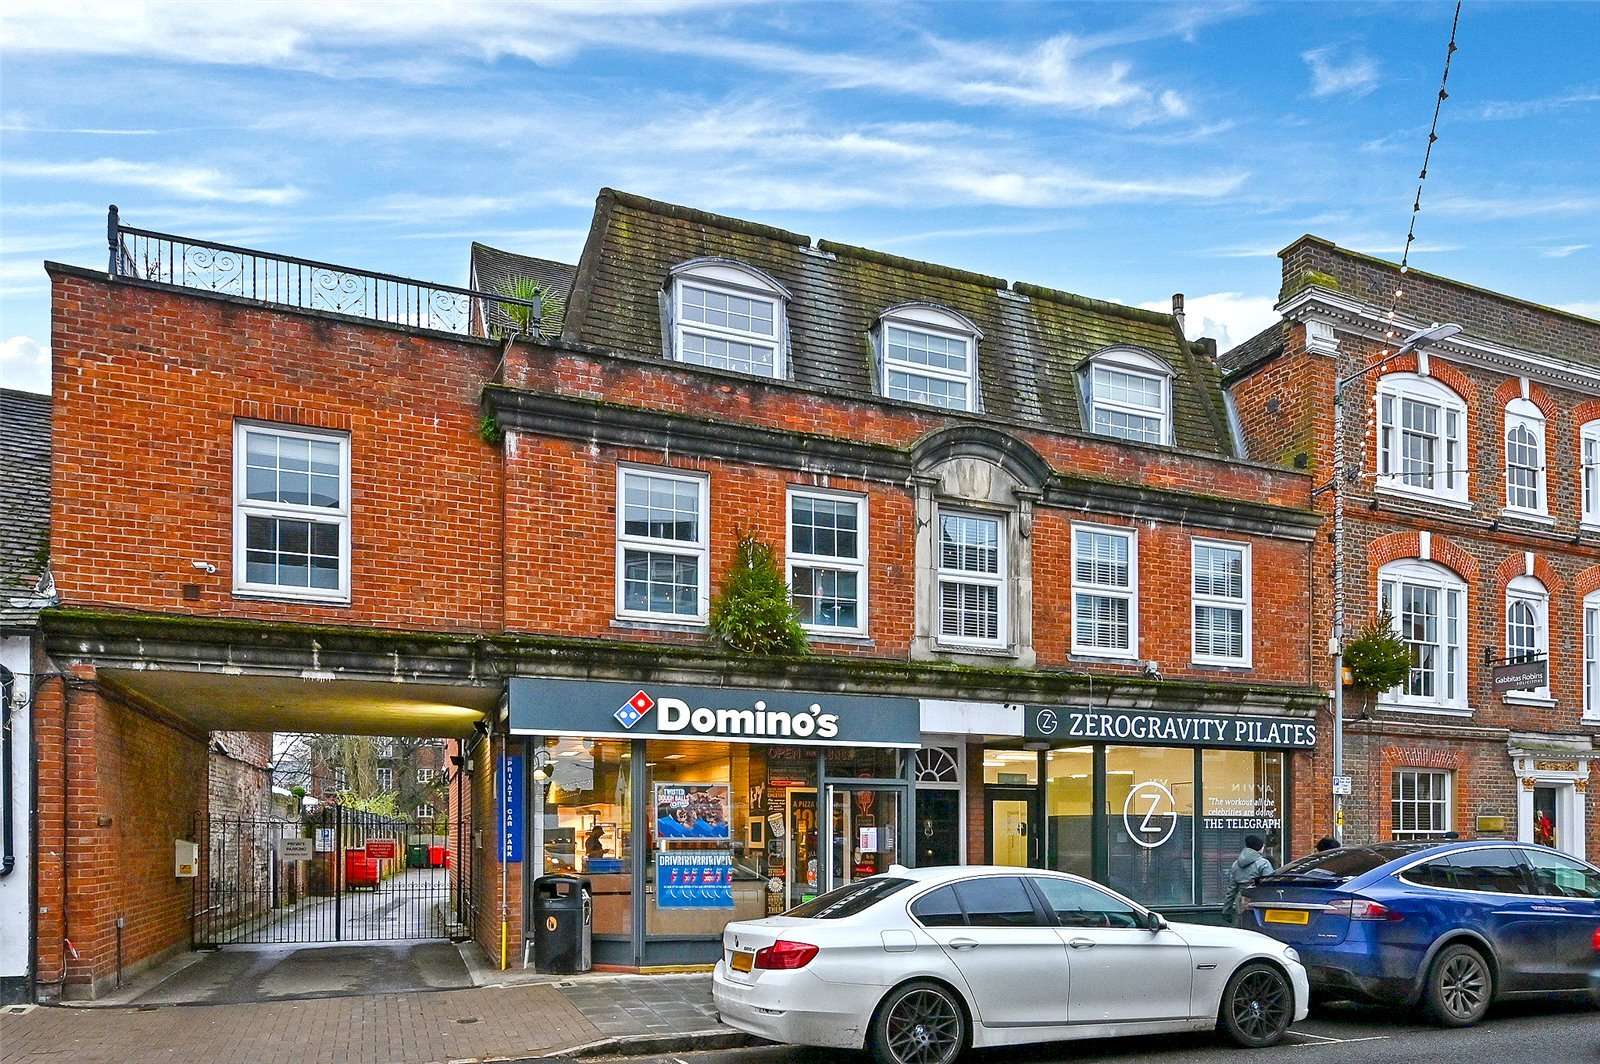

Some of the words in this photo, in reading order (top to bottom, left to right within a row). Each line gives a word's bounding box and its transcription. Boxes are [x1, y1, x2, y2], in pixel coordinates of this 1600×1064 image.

[1495, 675, 1521, 684] Gabbitas
[1521, 673, 1543, 681] Robins
[656, 697, 839, 738] Domino's
[1069, 713, 1230, 741] ZEROGRAVITY
[1235, 720, 1317, 746] PILATES
[1208, 807, 1242, 816] celebrities
[1203, 818, 1224, 829] THE
[1226, 818, 1281, 829] TELEGRAPH
